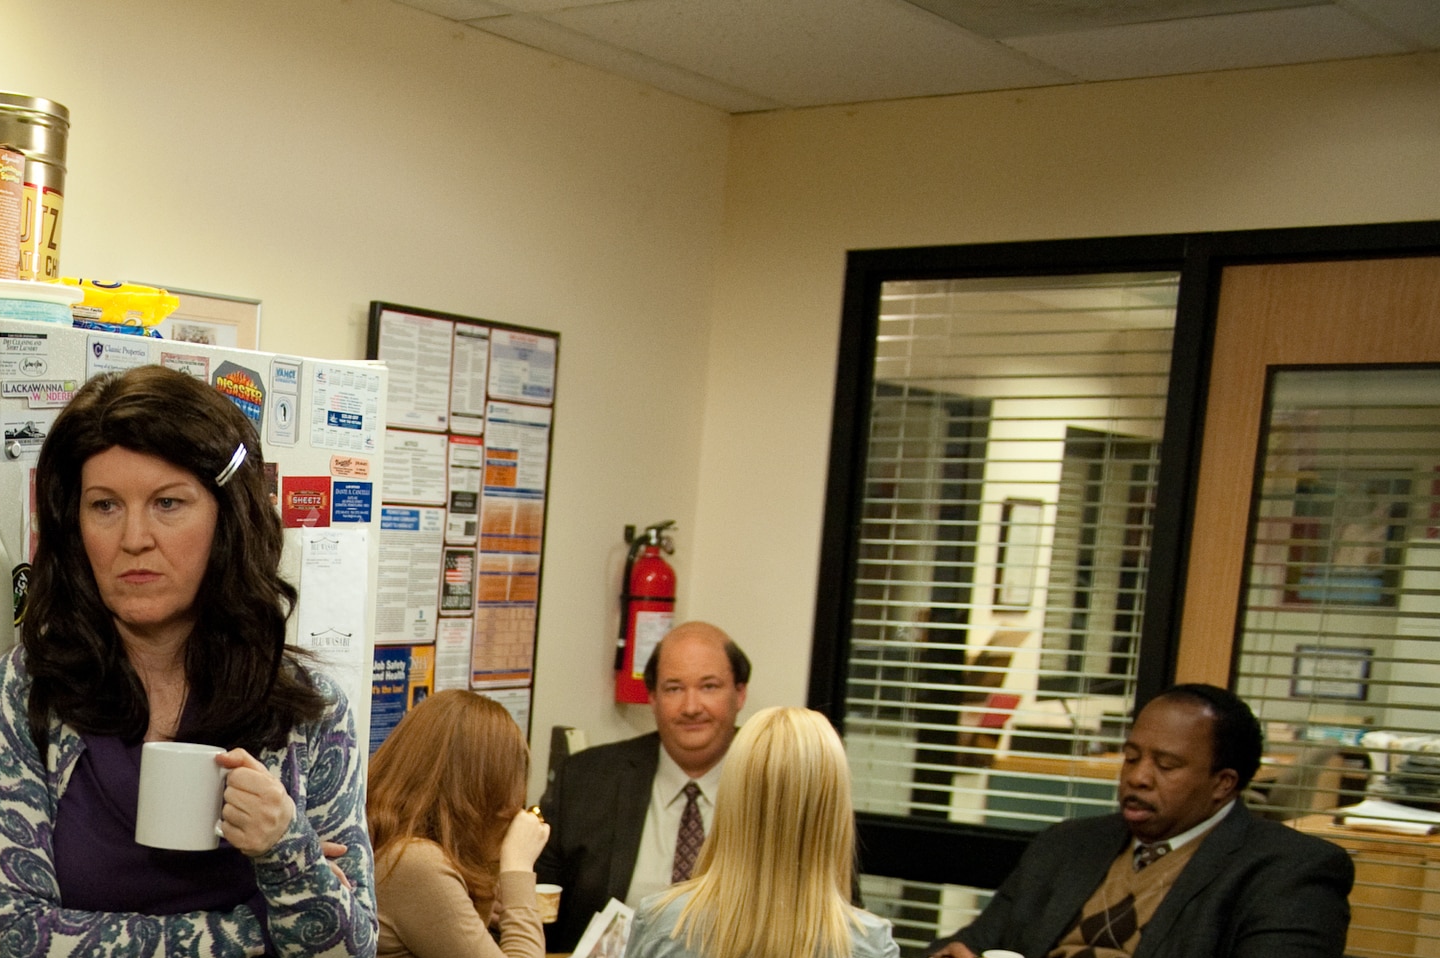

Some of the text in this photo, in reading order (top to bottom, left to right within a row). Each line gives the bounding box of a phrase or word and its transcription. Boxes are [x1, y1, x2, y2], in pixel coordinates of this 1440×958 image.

[292, 496, 321, 504] SHEETZ
[14, 572, 28, 597] GGY
[385, 660, 407, 672] Safety
